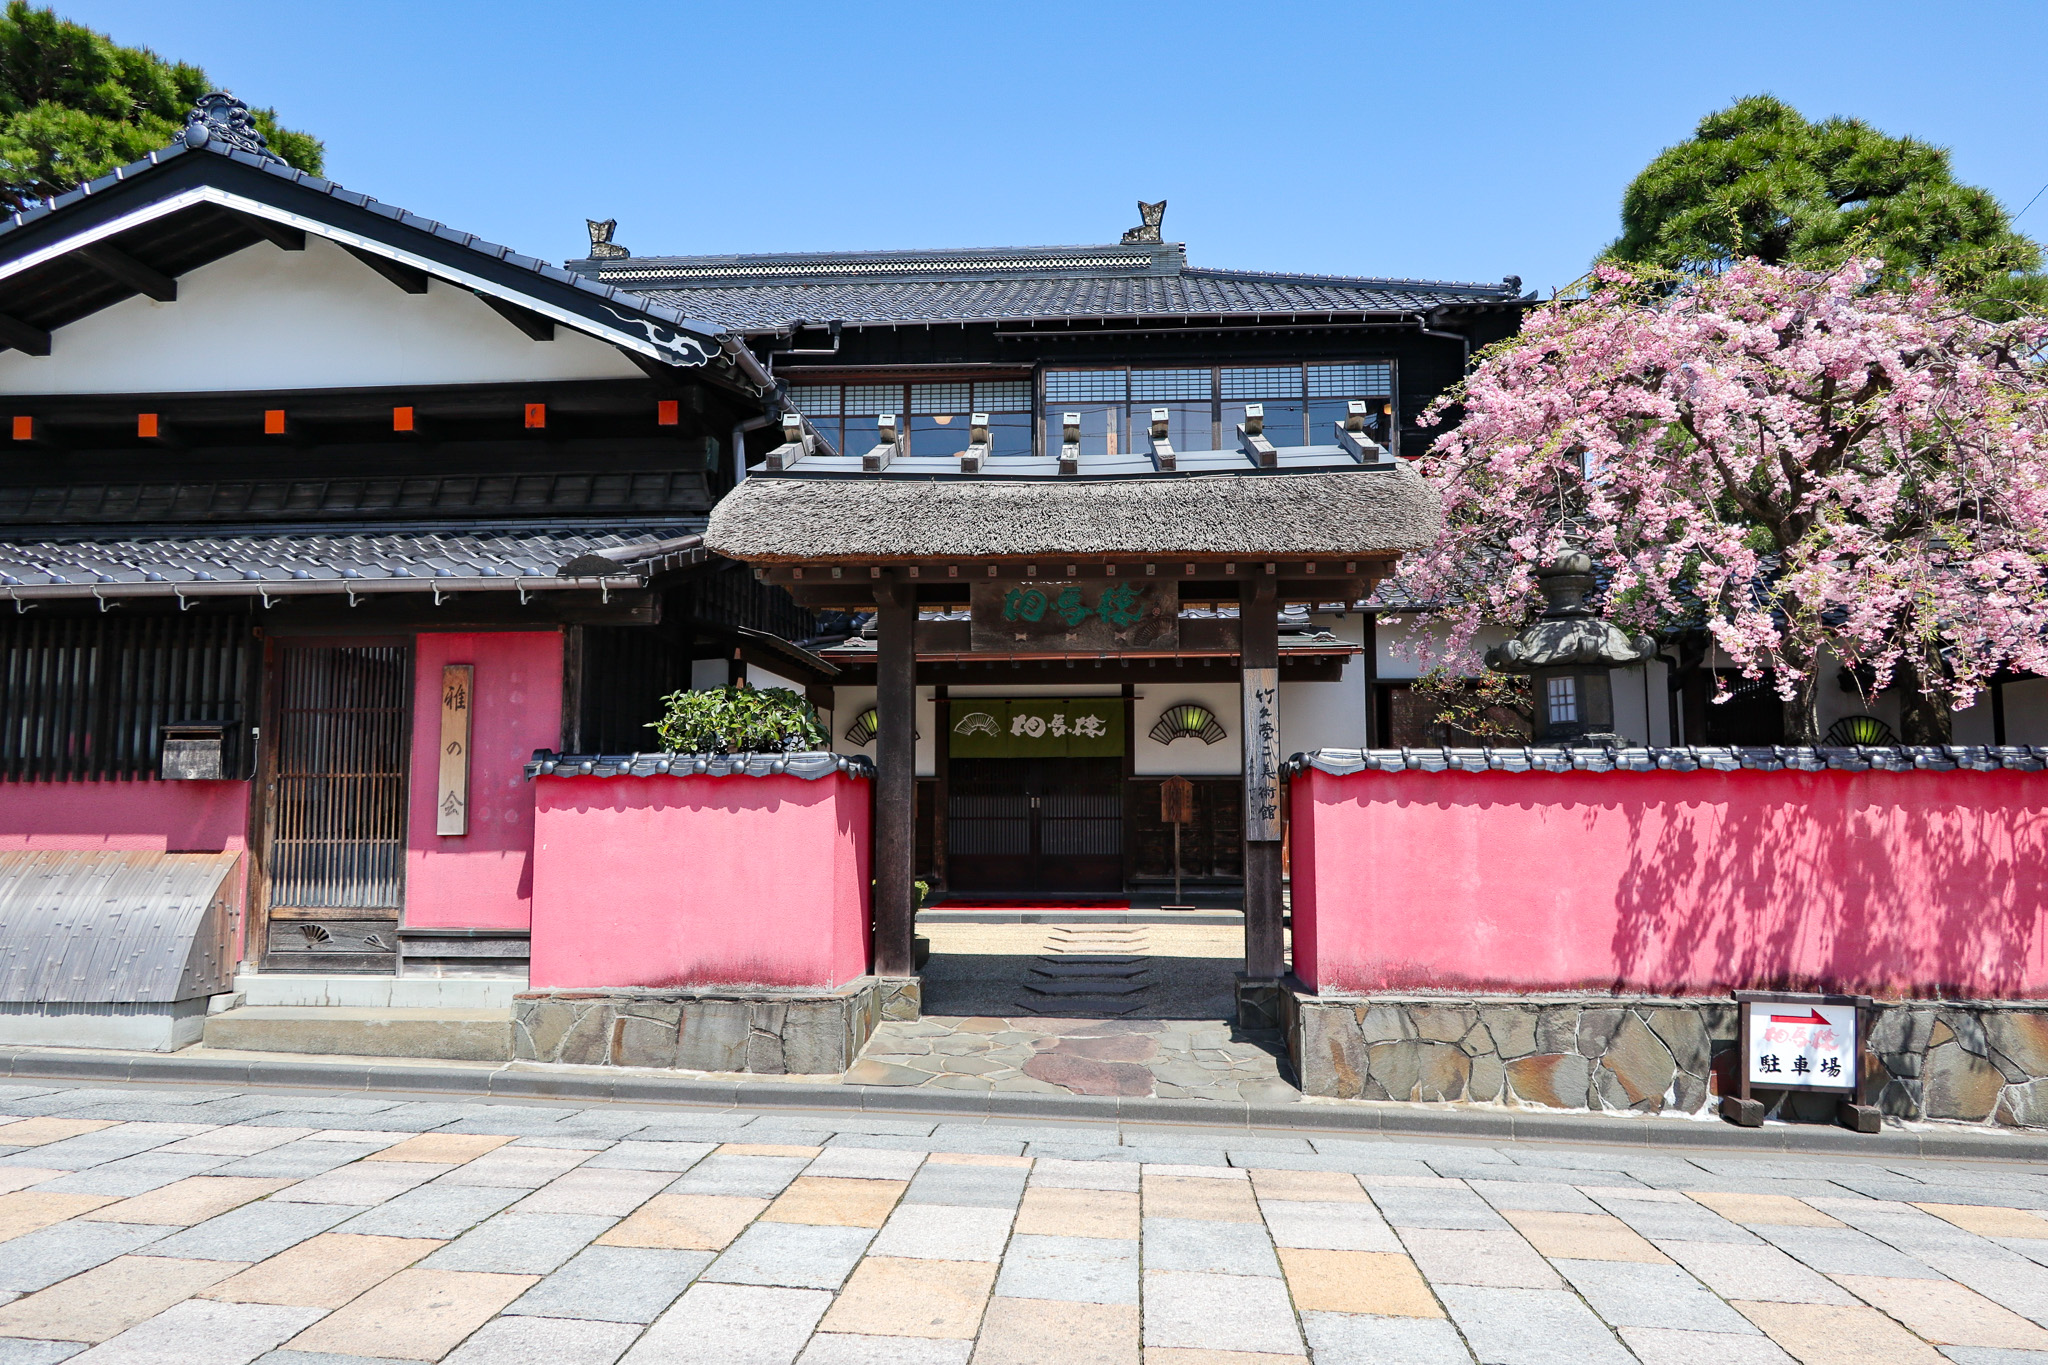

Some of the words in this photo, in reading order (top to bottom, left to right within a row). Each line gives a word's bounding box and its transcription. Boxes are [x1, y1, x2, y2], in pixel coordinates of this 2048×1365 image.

[440, 684, 466, 816] 雅の会
[1255, 688, 1277, 820] 竹久夢二美術館
[1759, 1054, 1842, 1078] 駐車場
